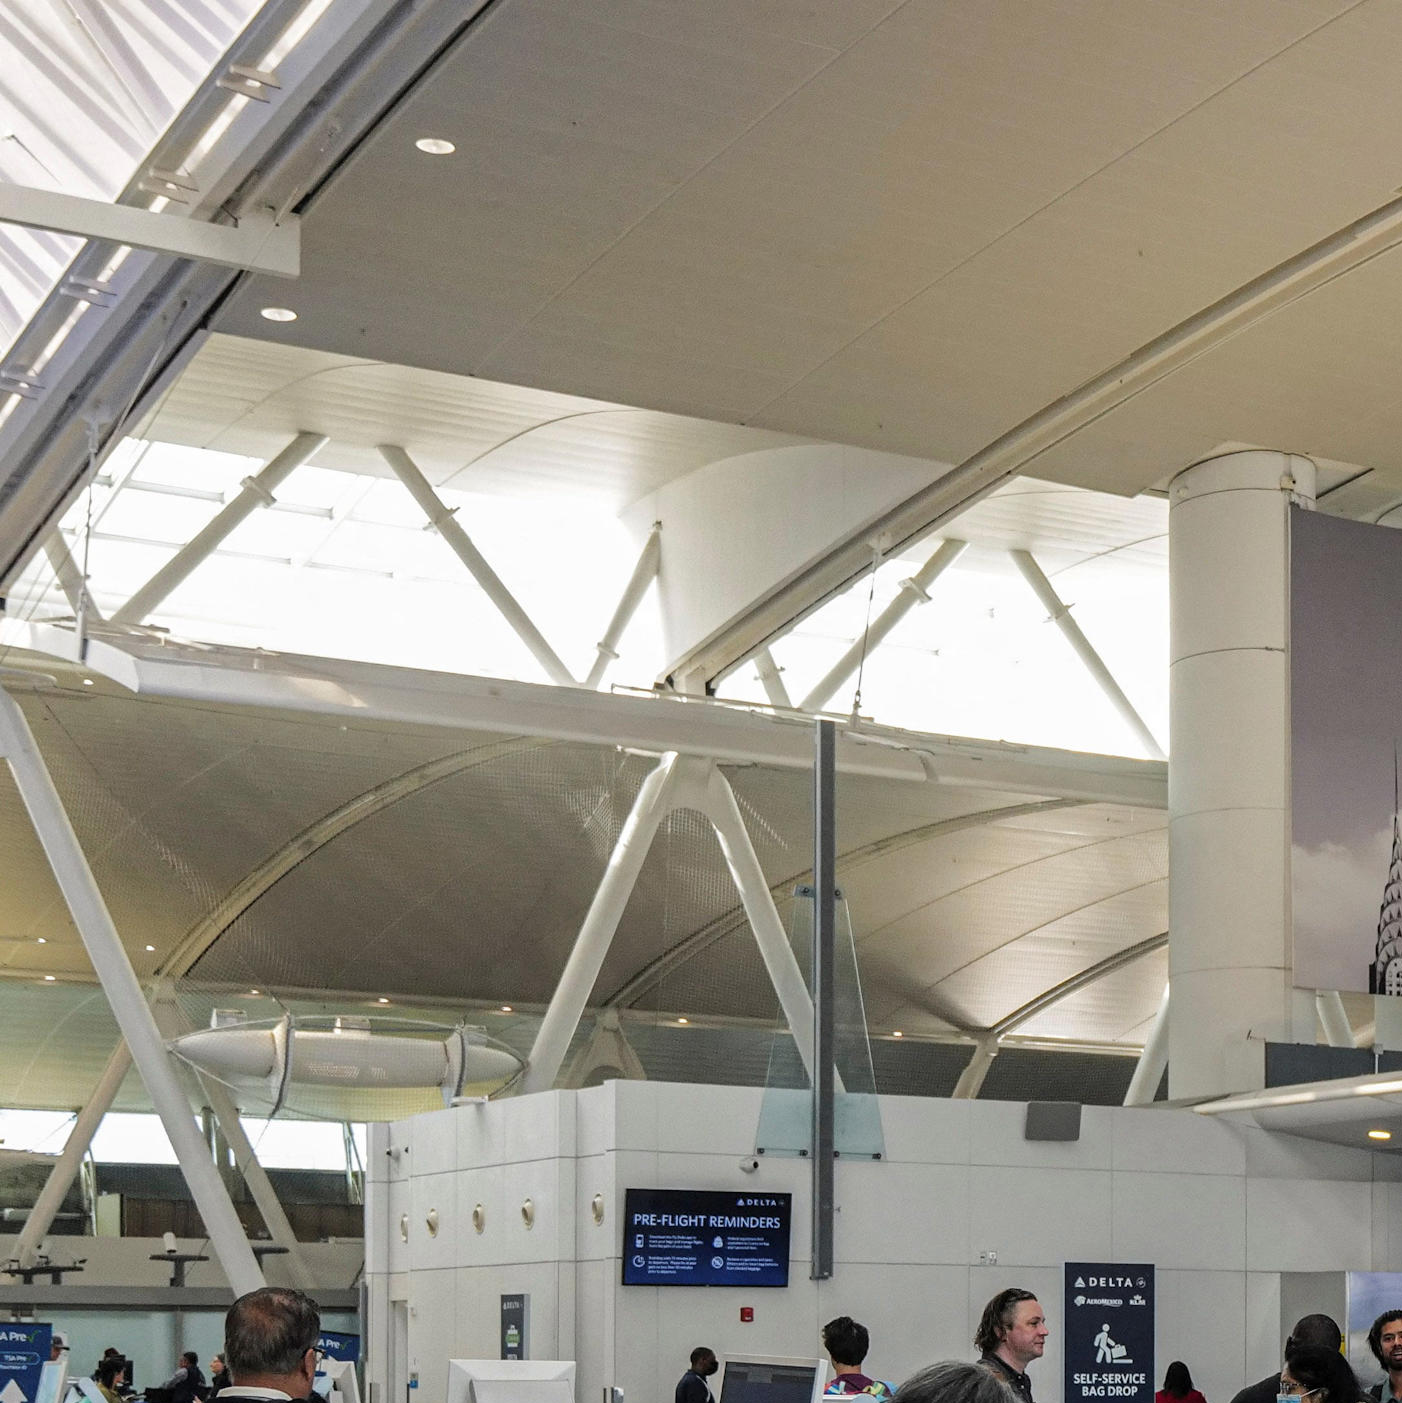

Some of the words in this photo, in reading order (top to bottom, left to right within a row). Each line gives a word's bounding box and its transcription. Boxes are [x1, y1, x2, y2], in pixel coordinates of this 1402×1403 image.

[634, 1214, 706, 1226] PRE-FLIGHT
[710, 1216, 780, 1228] REMINDERS
[1089, 1277, 1133, 1287] DELTA
[1074, 1373, 1146, 1384] SELF-SERVICE
[1082, 1386, 1105, 1396] BAG
[1108, 1386, 1138, 1396] DROP
